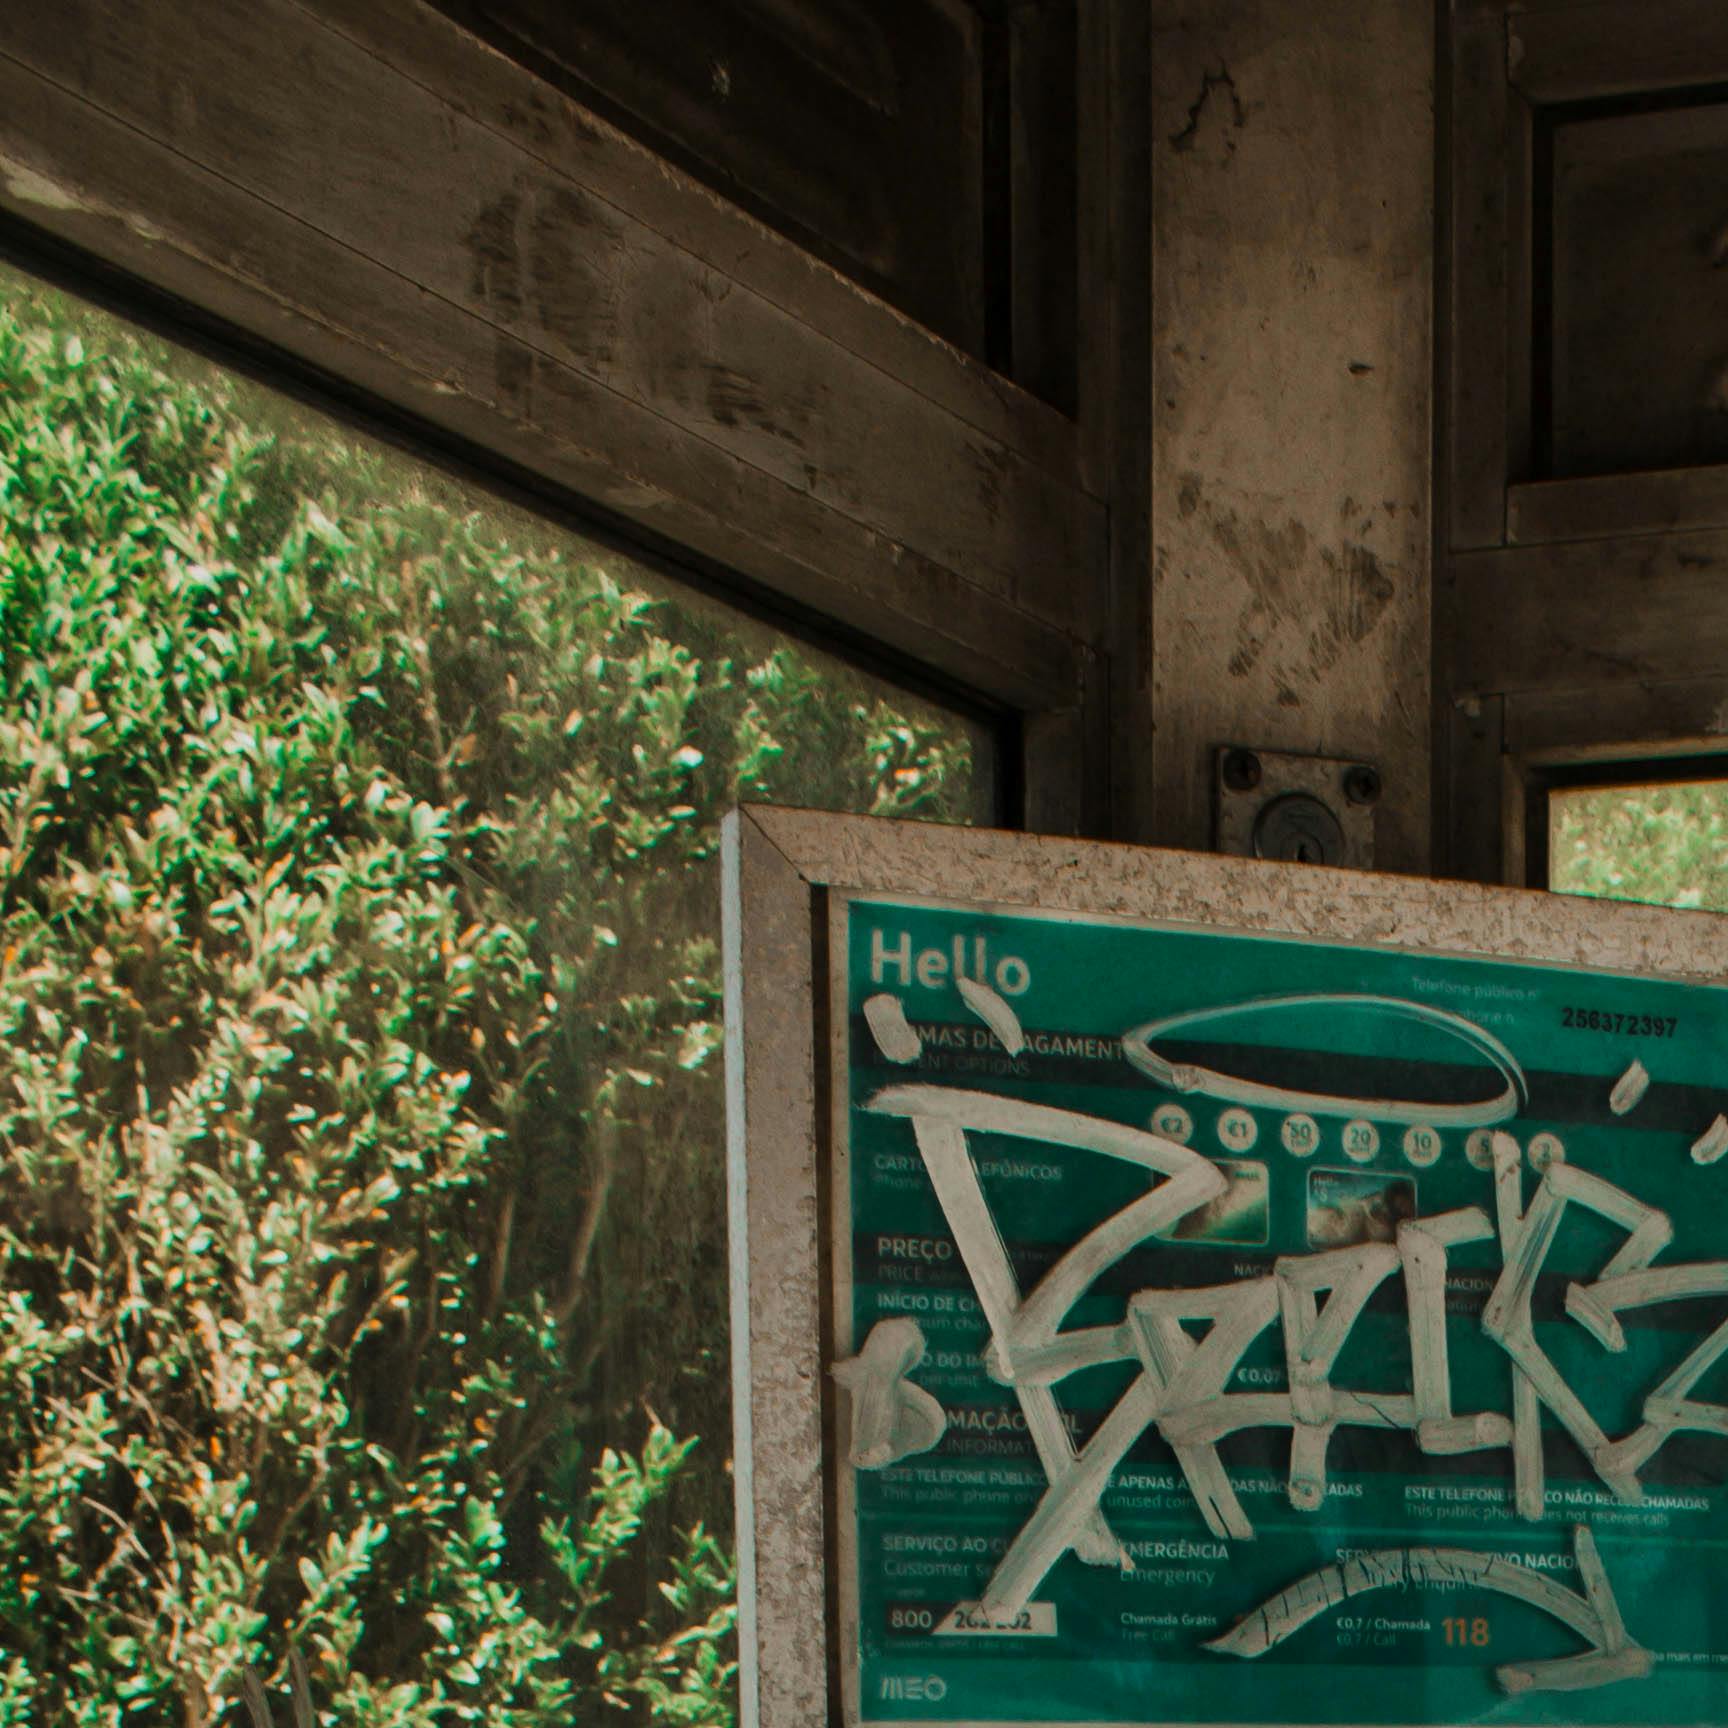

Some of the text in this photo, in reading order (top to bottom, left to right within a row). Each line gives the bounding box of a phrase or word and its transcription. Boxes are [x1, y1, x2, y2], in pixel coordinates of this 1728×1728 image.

[872, 928, 1031, 996] Hello
[1562, 1007, 1679, 1038] 256372397
[1290, 1126, 1311, 1141] 50
[1350, 1129, 1371, 1145] 20
[1413, 1136, 1432, 1150] 10
[877, 1236, 953, 1264] PREÇO
[878, 1265, 922, 1282] PRICE
[877, 1291, 929, 1312] INÍCIO
[934, 1297, 955, 1312] DE
[1119, 1475, 1175, 1491] APENAS
[1405, 1485, 1436, 1500] ESTE
[1439, 1487, 1505, 1503] TELEFONE
[1565, 1489, 1594, 1506] NÃO
[1405, 1504, 1434, 1519] This
[1437, 1504, 1479, 1522] public
[1566, 1509, 1587, 1522] not
[881, 1535, 958, 1557] SERVIÇO
[962, 1537, 988, 1554] AO
[883, 1560, 970, 1578] Customer
[891, 1609, 933, 1629] 800
[1375, 1618, 1431, 1633] Chamada
[1441, 1618, 1489, 1646] 118
